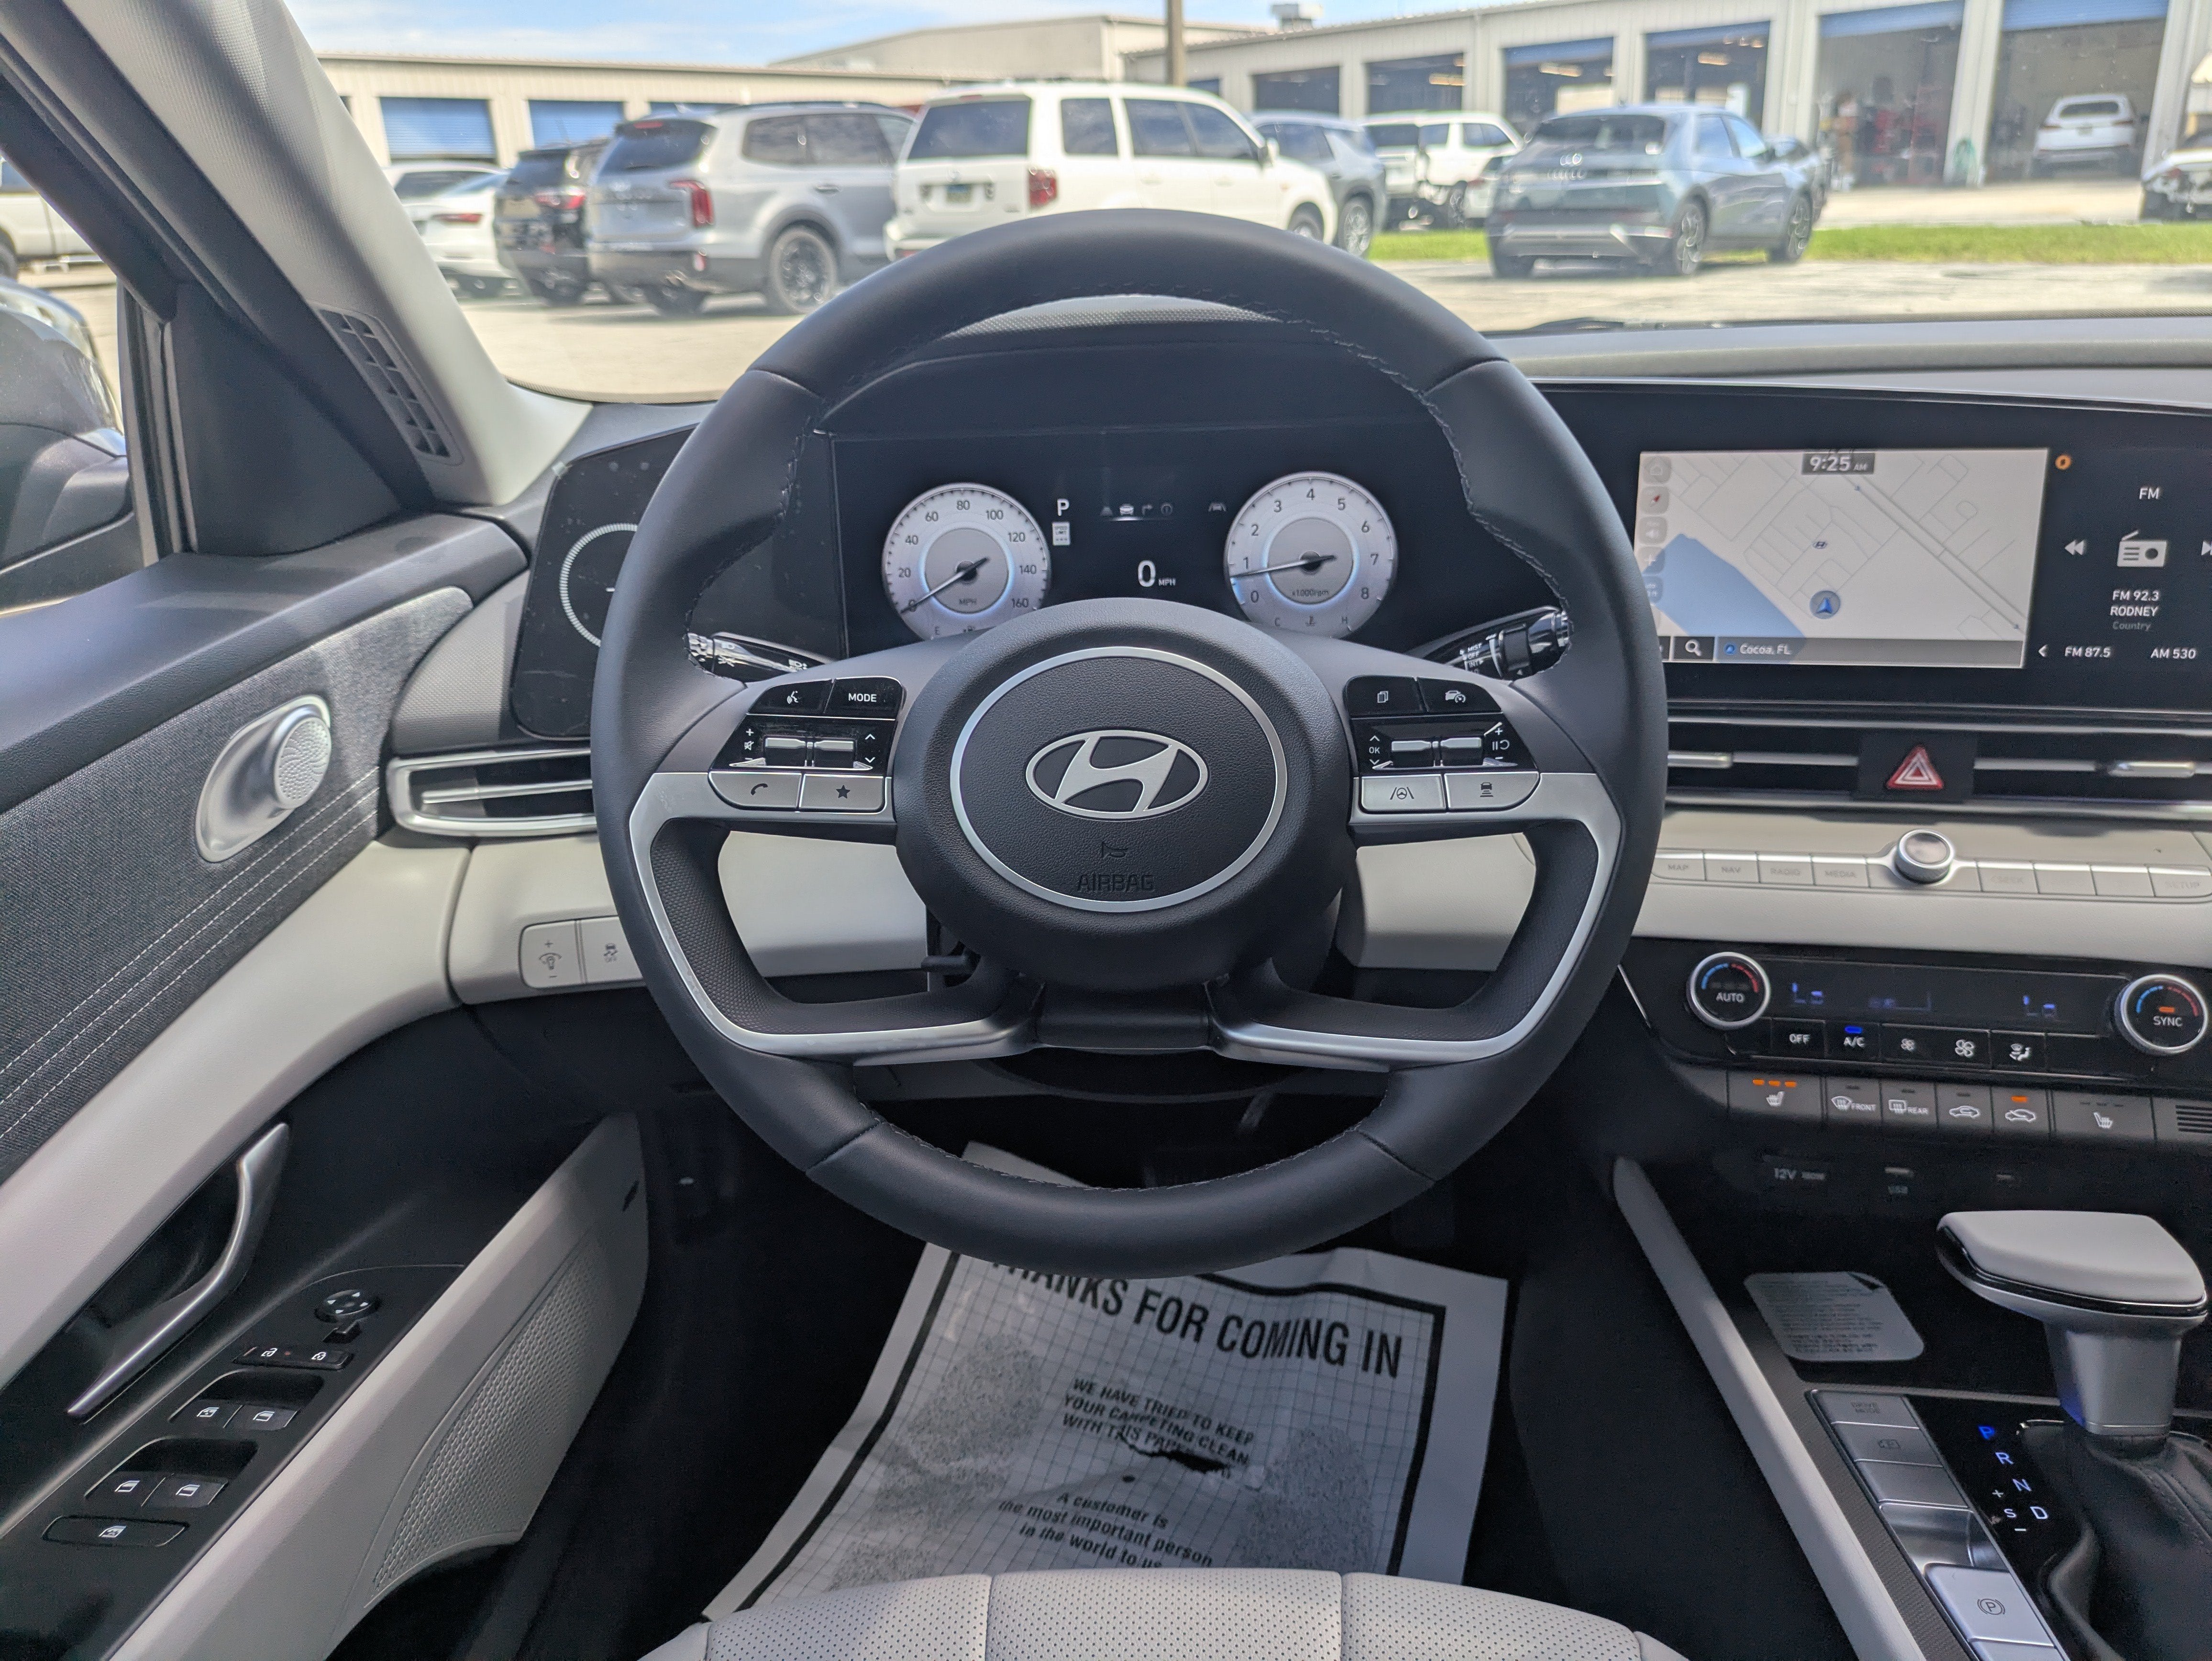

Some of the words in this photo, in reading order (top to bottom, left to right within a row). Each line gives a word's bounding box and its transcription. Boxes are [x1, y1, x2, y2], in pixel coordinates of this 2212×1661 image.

[1809, 455, 1851, 473] 9:25
[1853, 463, 1867, 472] AM
[1306, 488, 1315, 500] 4
[2139, 487, 2160, 500] FM
[957, 500, 970, 510] 80
[1057, 498, 1070, 516] P
[1273, 500, 1282, 512] 3
[1338, 497, 1346, 510] 5
[925, 511, 939, 521] 60
[986, 510, 1004, 520] 100
[1251, 524, 1259, 536] 2
[1361, 520, 1370, 533] 6
[905, 535, 918, 544] 40
[1008, 532, 1025, 542] 120
[1244, 557, 1249, 569] 1
[1370, 554, 1379, 565] 7
[898, 568, 911, 577] 20
[1020, 565, 1037, 575] 140
[1138, 560, 1156, 587] 0
[1158, 578, 1176, 586] MPH
[1250, 591, 1259, 603] 0
[1361, 587, 1369, 599] 8
[2112, 590, 2130, 601] FM
[2133, 590, 2159, 601] 92.3
[1011, 598, 1029, 608] 160
[2110, 606, 2158, 617] RODNEY
[934, 626, 940, 635] E
[2112, 621, 2151, 632] Country
[1467, 642, 1482, 652] MIST
[1777, 643, 1791, 655] FL
[2065, 647, 2082, 657] FM
[2084, 647, 2111, 658] 87.5
[1468, 651, 1479, 659] OFF
[2150, 648, 2170, 659] AM
[2172, 648, 2197, 659] 530
[848, 693, 877, 702] MODE
[1770, 868, 1801, 876] RADIO
[1077, 874, 1155, 893] AIRBAG
[1716, 992, 1745, 1003] AUTO
[2153, 1016, 2183, 1028] SYNC
[1789, 1034, 1811, 1044] OFF
[1844, 1037, 1864, 1048] A/C
[1851, 1103, 1876, 1111] FRONT
[1774, 1168, 1797, 1180] 12V
[1133, 1287, 1209, 1343] FOR
[1216, 1314, 1349, 1367] COMING
[1361, 1329, 1402, 1379] IN
[1073, 1378, 1096, 1395] WE
[1100, 1386, 1140, 1407] HAVE
[1144, 1397, 1189, 1420] TRIED
[1193, 1413, 1212, 1430] TO
[1215, 1421, 1254, 1446] KEEP
[1062, 1413, 1101, 1434] WITH
[1107, 1424, 1142, 1441] THIS
[1065, 1393, 1106, 1417] YOUR
[1109, 1406, 1195, 1442] CARPETING
[1198, 1436, 1250, 1465] CLEAN
[1978, 1425, 1995, 1440] P
[1995, 1452, 2014, 1464] R
[2012, 1479, 2032, 1492] N
[1057, 1492, 1069, 1504] A
[1073, 1495, 1149, 1523] customer
[1152, 1513, 1169, 1529] is
[2004, 1508, 2017, 1518] S
[2030, 1506, 2048, 1520] D
[998, 1500, 1024, 1514] the
[1027, 1506, 1068, 1525] most
[1071, 1514, 1152, 1548] important
[1151, 1537, 1213, 1568] person
[1019, 1522, 1036, 1538] in
[1040, 1525, 1064, 1542] the
[1069, 1534, 1117, 1560] world
[1120, 1548, 1137, 1567] to
